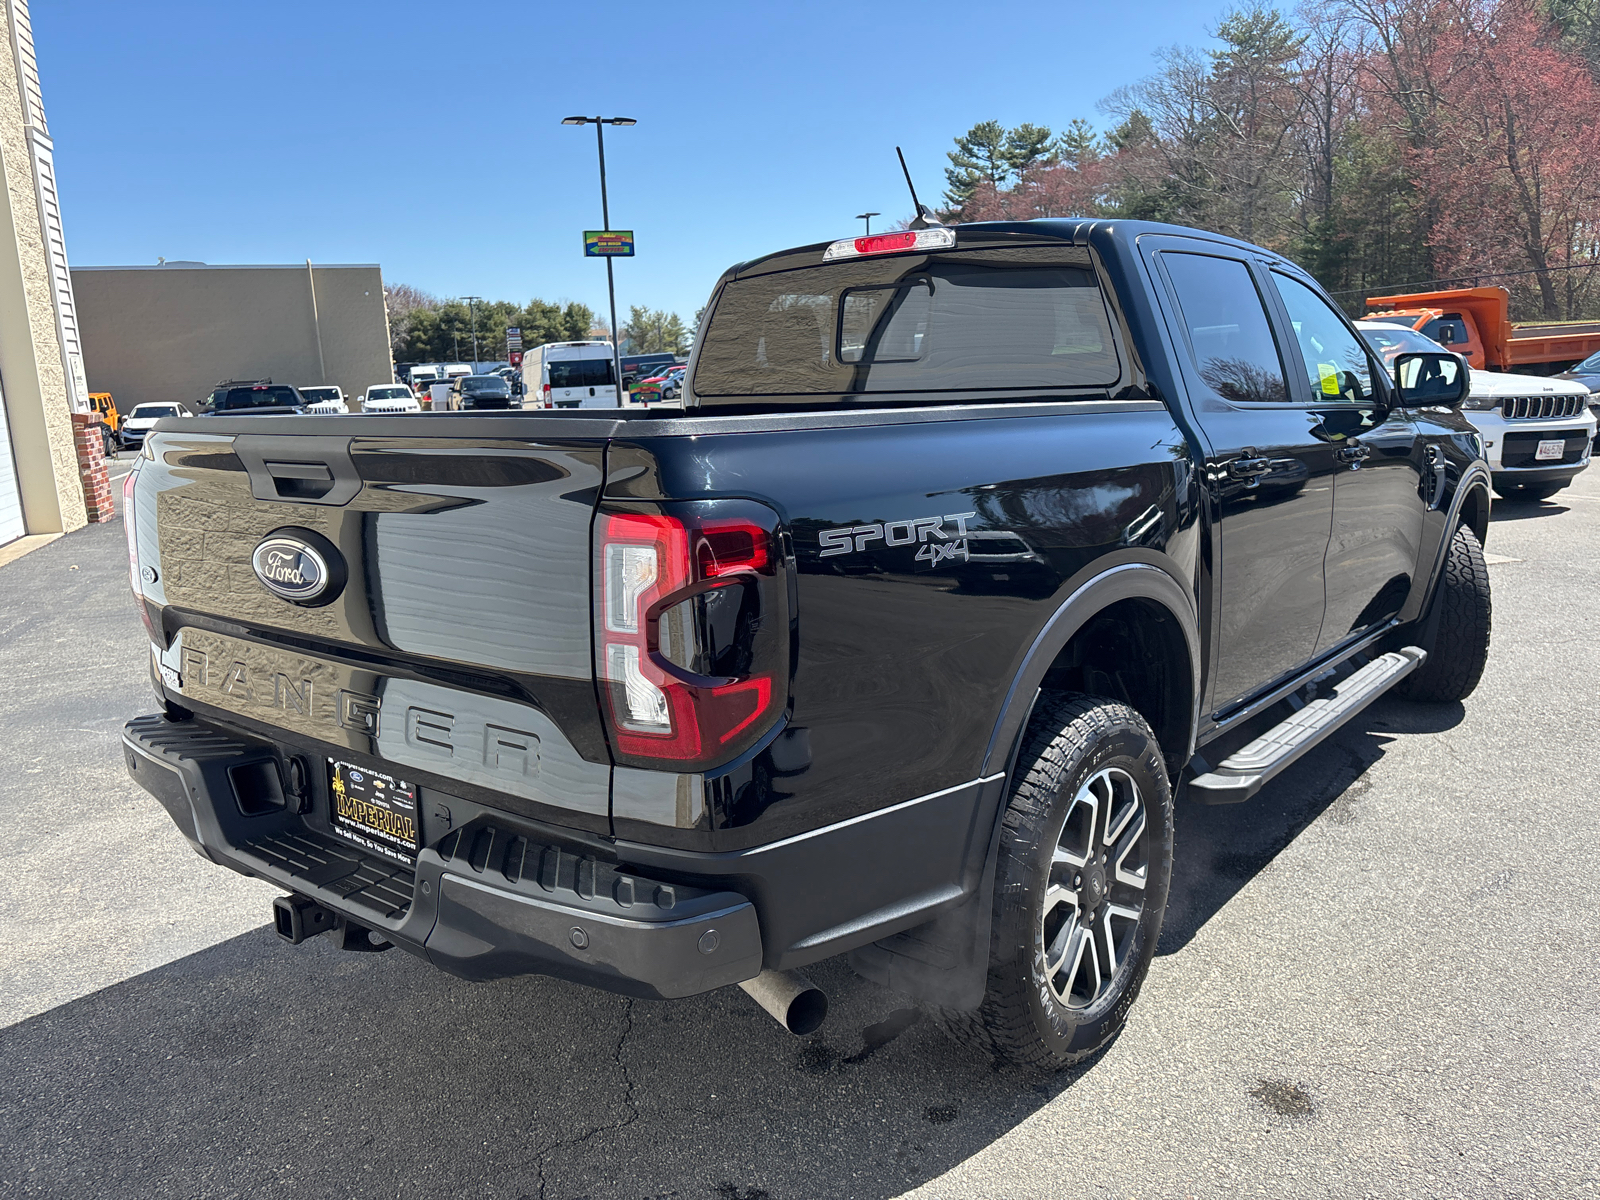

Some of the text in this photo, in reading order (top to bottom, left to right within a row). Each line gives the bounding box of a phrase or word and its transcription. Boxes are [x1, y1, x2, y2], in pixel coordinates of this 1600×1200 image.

[818, 511, 977, 558] SPORT
[265, 550, 304, 585] Ford
[180, 645, 541, 780] RANGER
[336, 792, 416, 843] IMPERIAL
[334, 826, 411, 865] We Sell More, So You Save More
